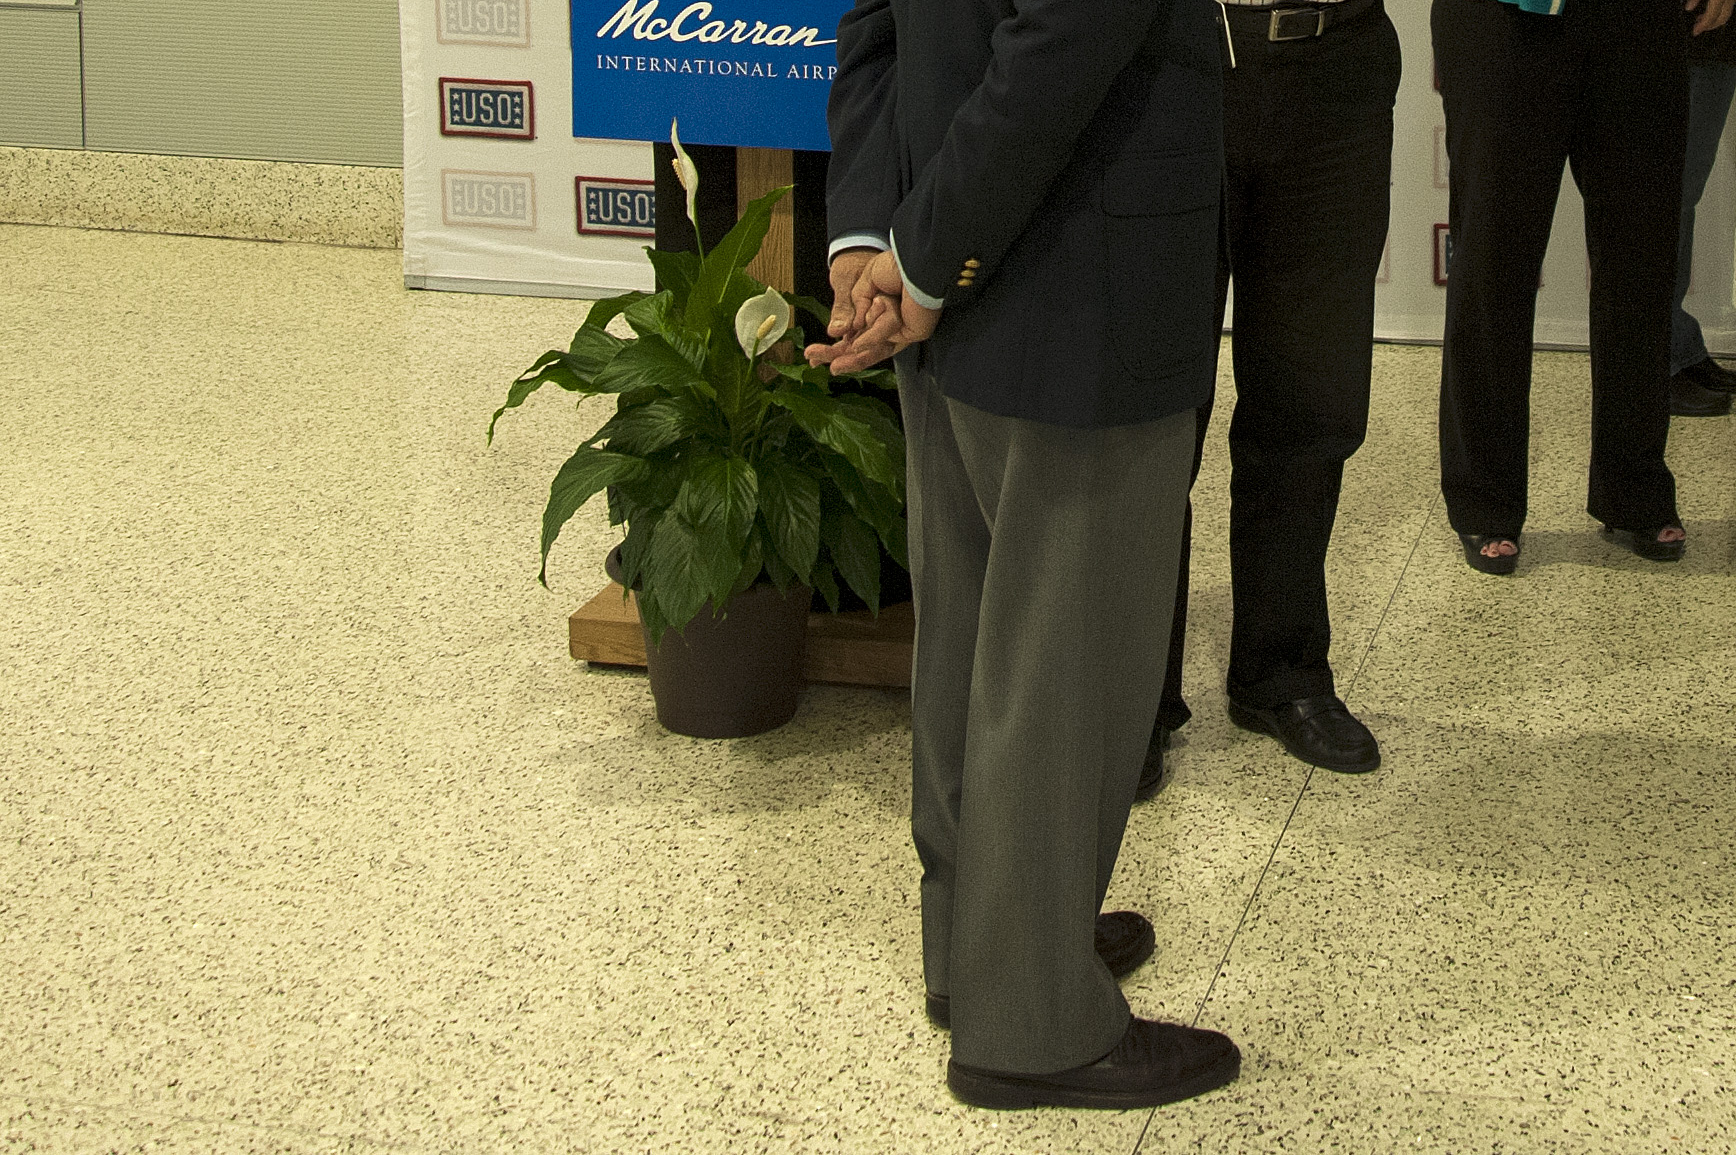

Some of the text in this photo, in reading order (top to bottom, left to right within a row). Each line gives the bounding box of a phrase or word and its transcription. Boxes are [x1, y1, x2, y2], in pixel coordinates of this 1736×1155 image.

[597, 54, 838, 81] INTERNATIONAL AIRP
[462, 93, 509, 125] USO
[599, 189, 649, 223] USO
